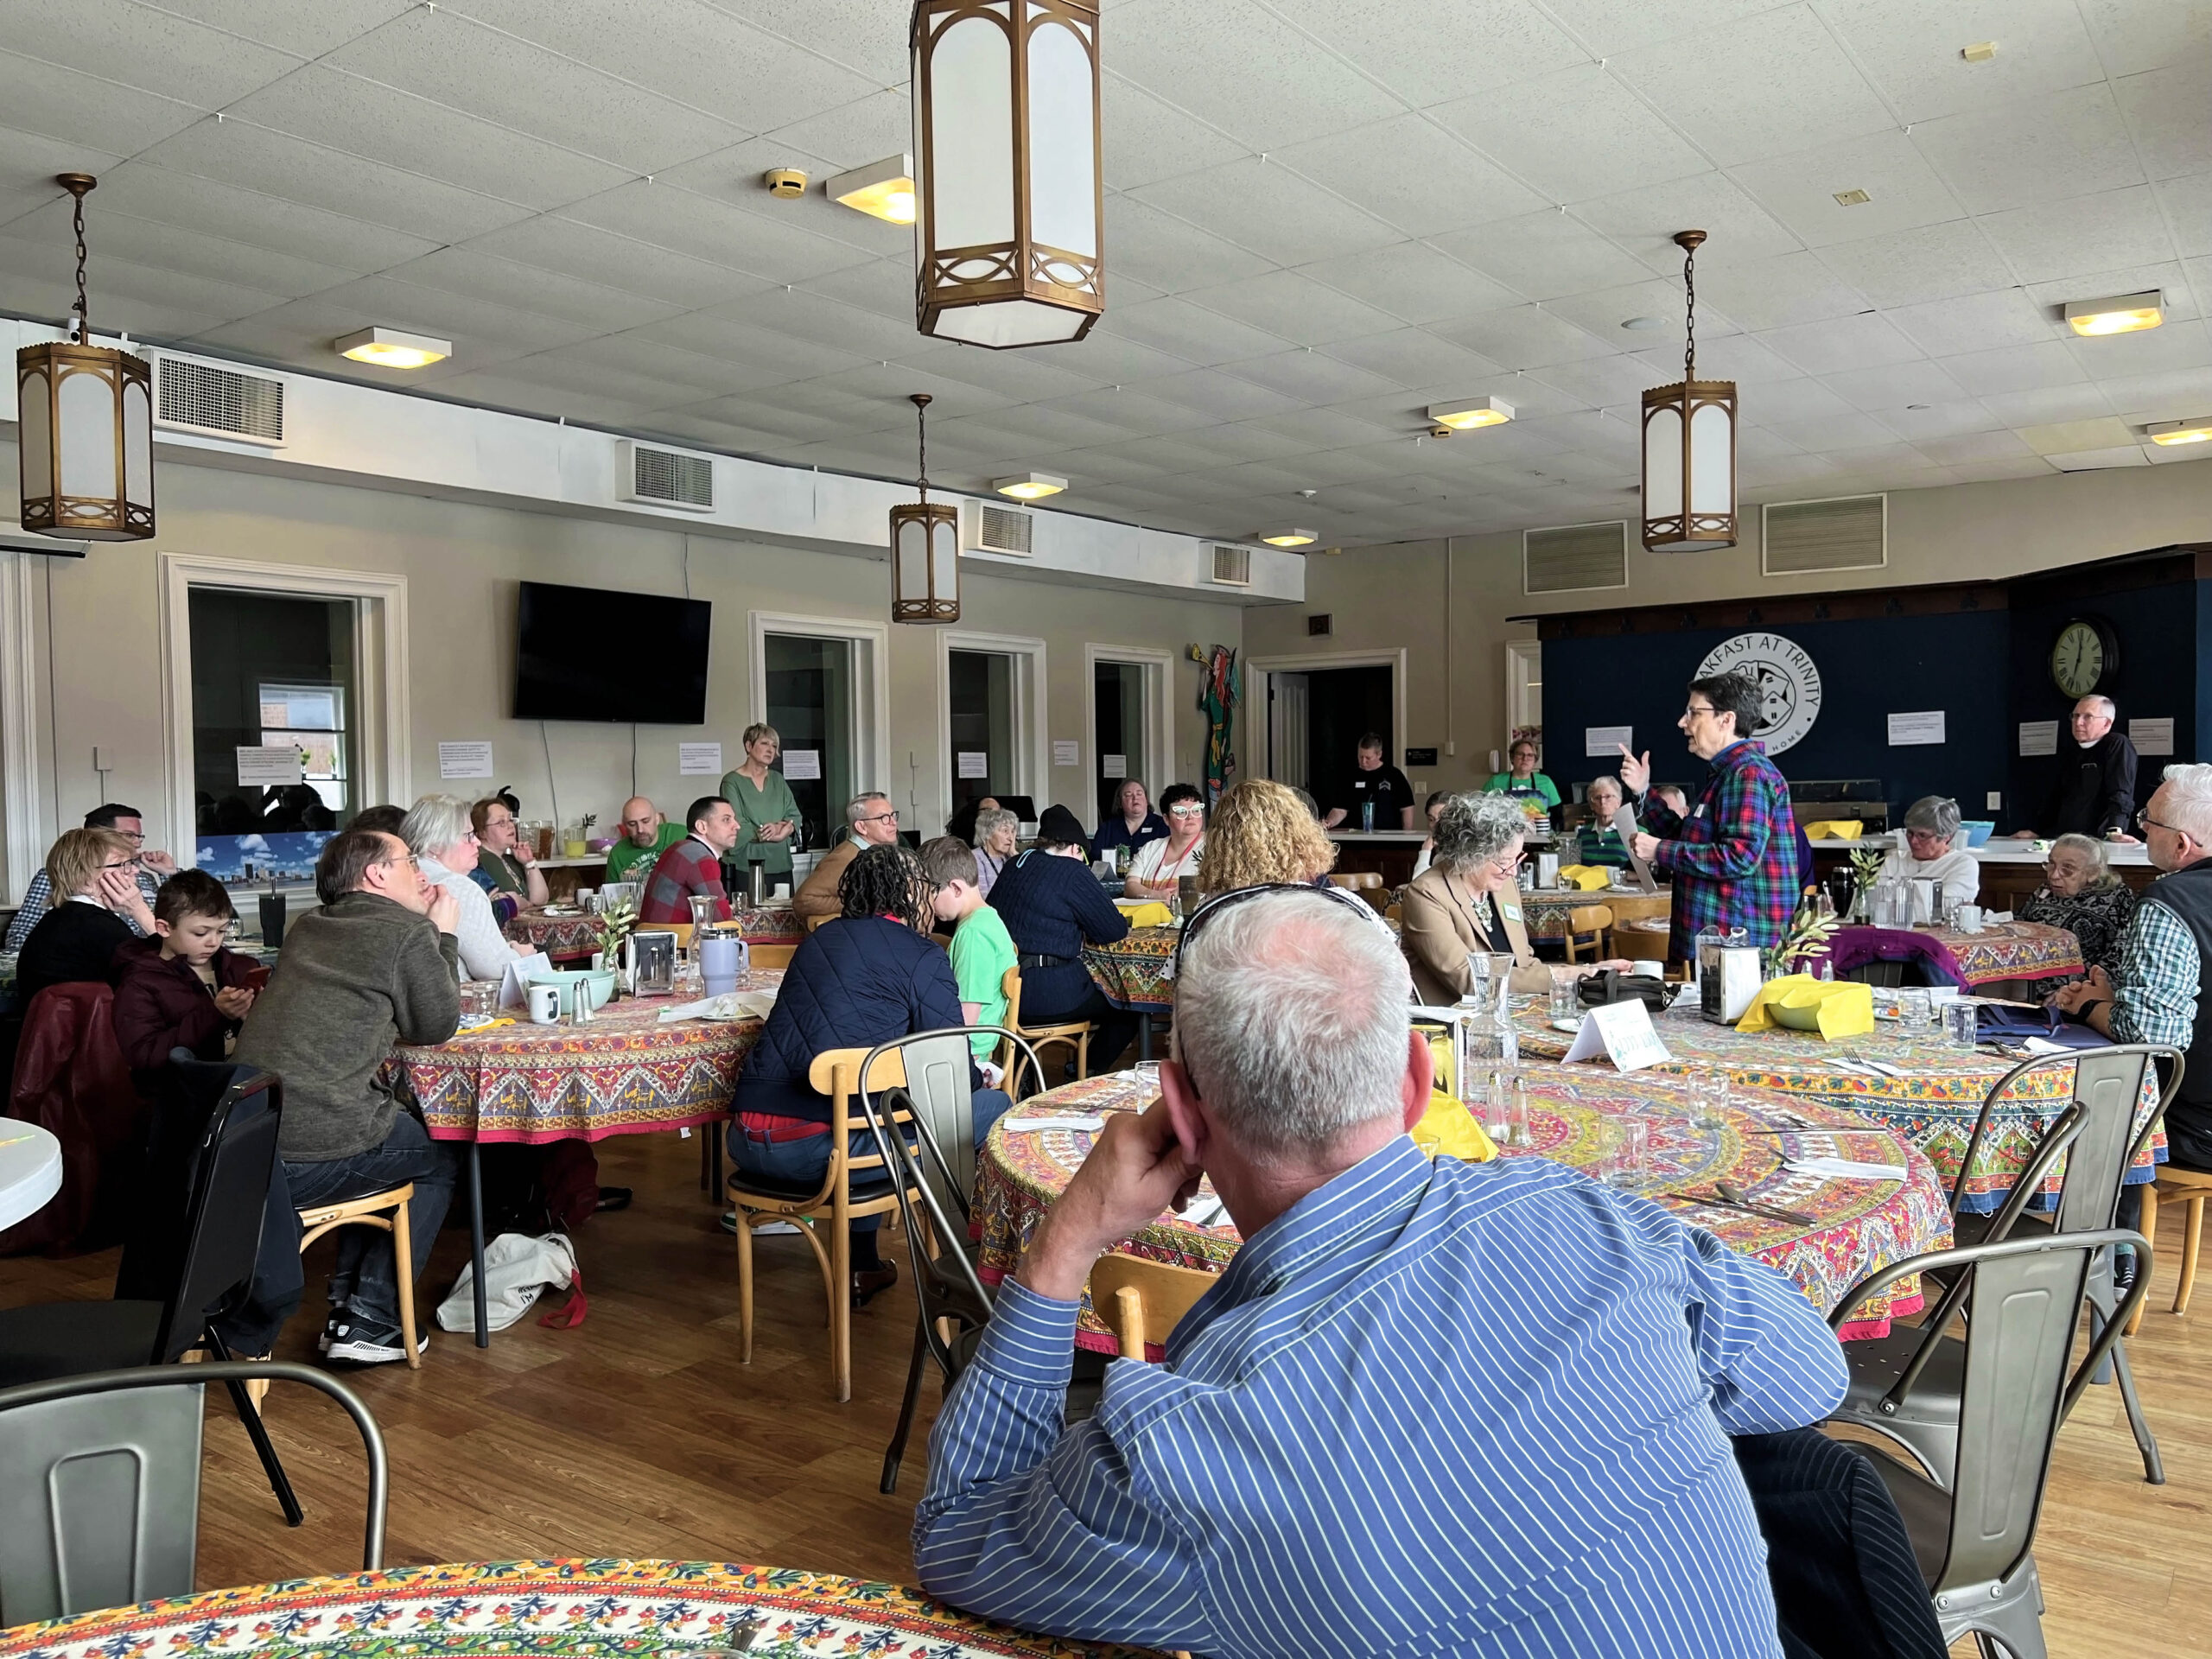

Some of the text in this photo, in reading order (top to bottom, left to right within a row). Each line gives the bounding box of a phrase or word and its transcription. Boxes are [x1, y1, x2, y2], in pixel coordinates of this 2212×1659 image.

[1699, 635, 1820, 707] AKFAST AT TRINITY
[1772, 729, 1802, 752] HOME
